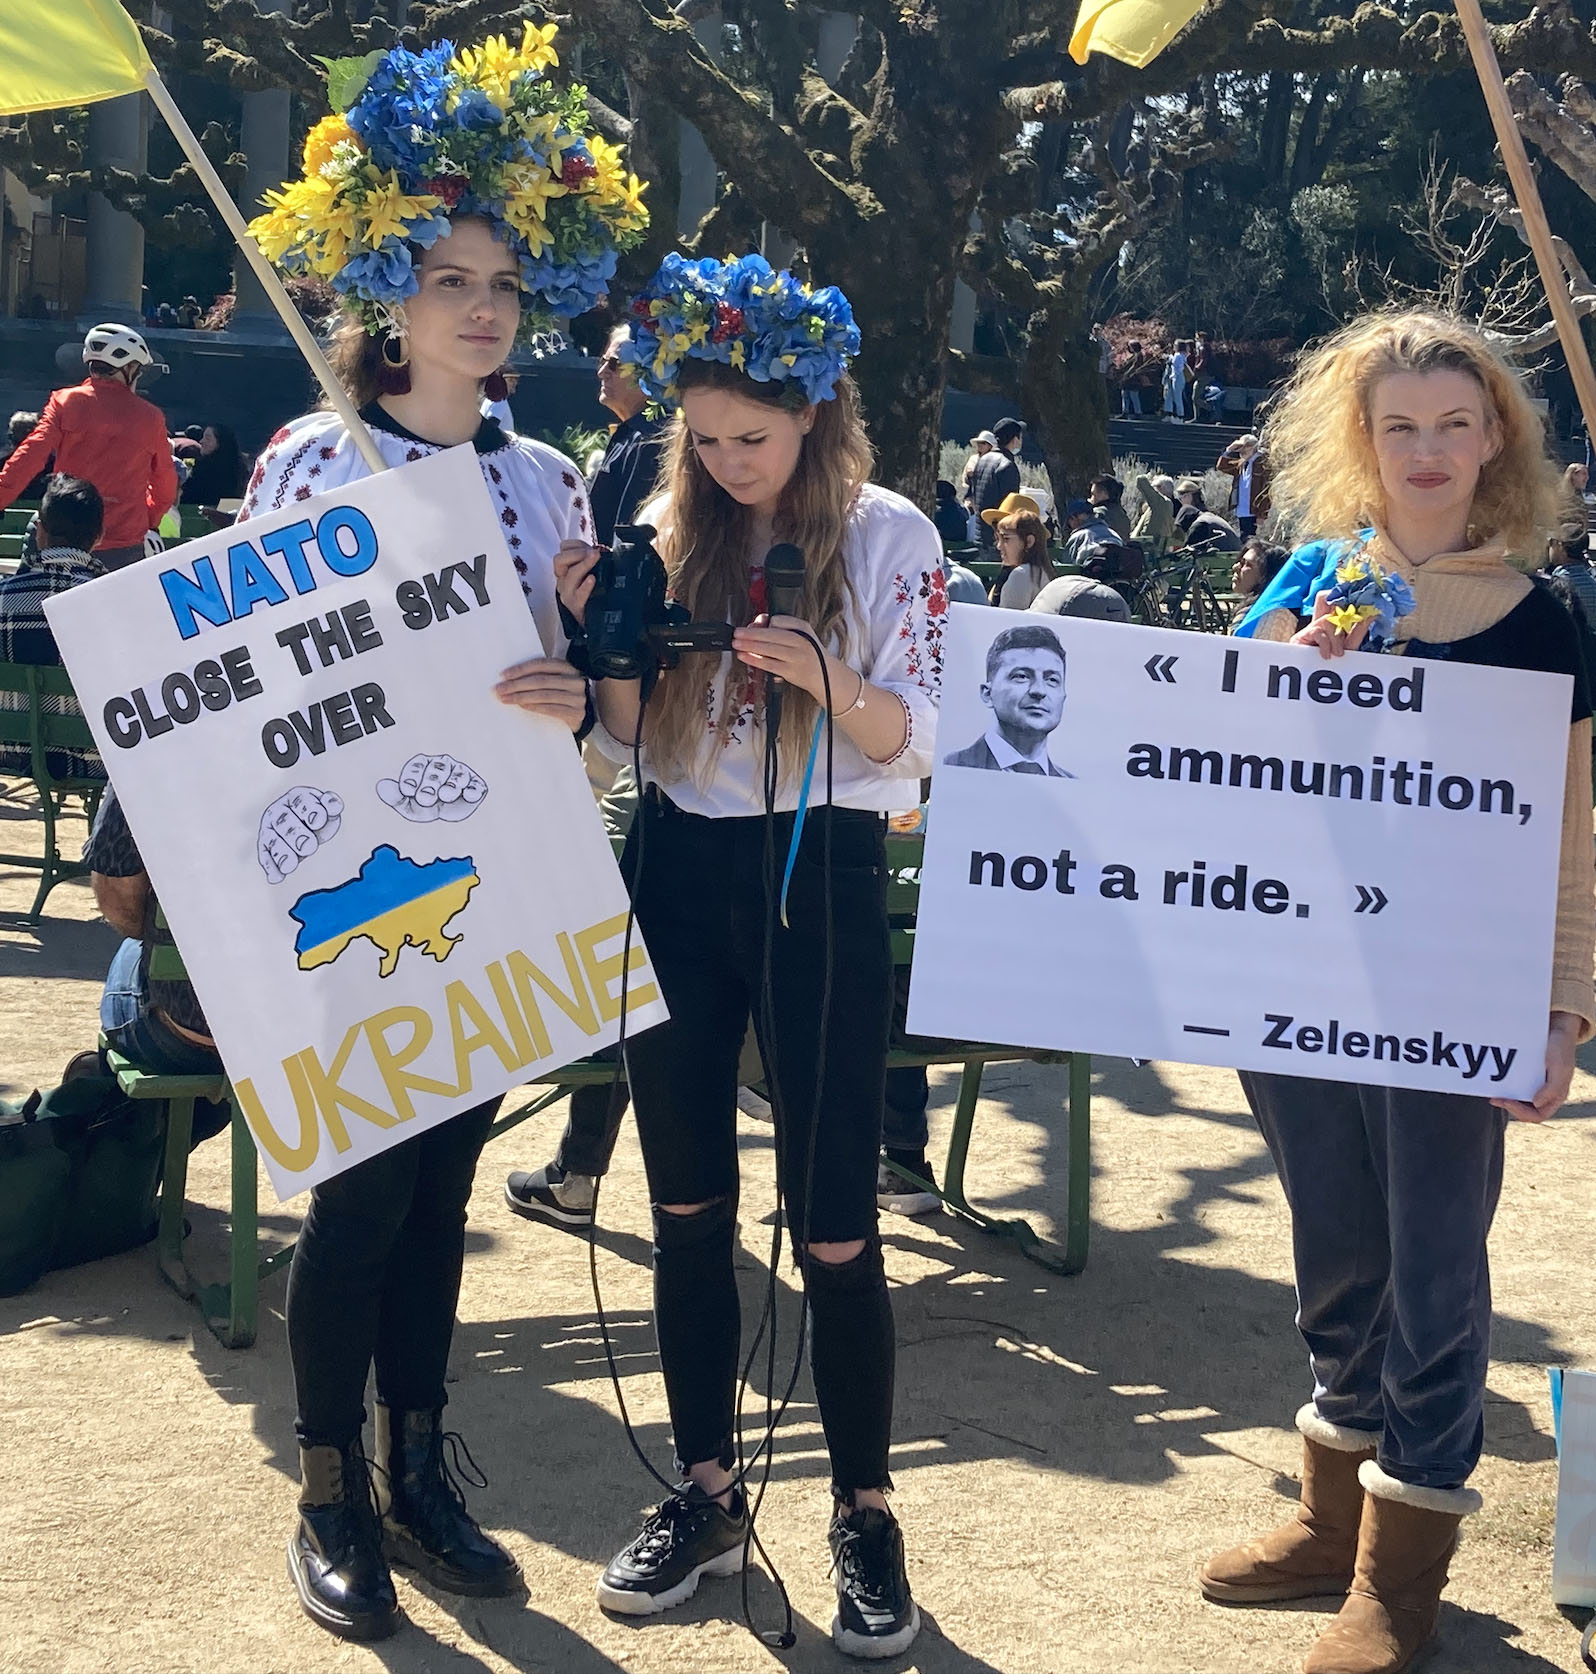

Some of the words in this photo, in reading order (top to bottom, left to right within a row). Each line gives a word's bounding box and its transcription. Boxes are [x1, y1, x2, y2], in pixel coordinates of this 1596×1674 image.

[159, 505, 379, 640] NATO
[103, 646, 262, 749] CLOSE
[276, 599, 384, 677] THE
[395, 553, 489, 631] SKY
[1220, 649, 1239, 693] I
[1267, 664, 1425, 713] need
[261, 682, 396, 768] OVER
[1126, 741, 1533, 826] ammunition,
[969, 848, 1077, 895] not
[1099, 864, 1139, 901] a
[1163, 860, 1310, 918] ride.
[234, 911, 659, 1173] UKRAINE
[1261, 1013, 1518, 1081] Zelenskyy
